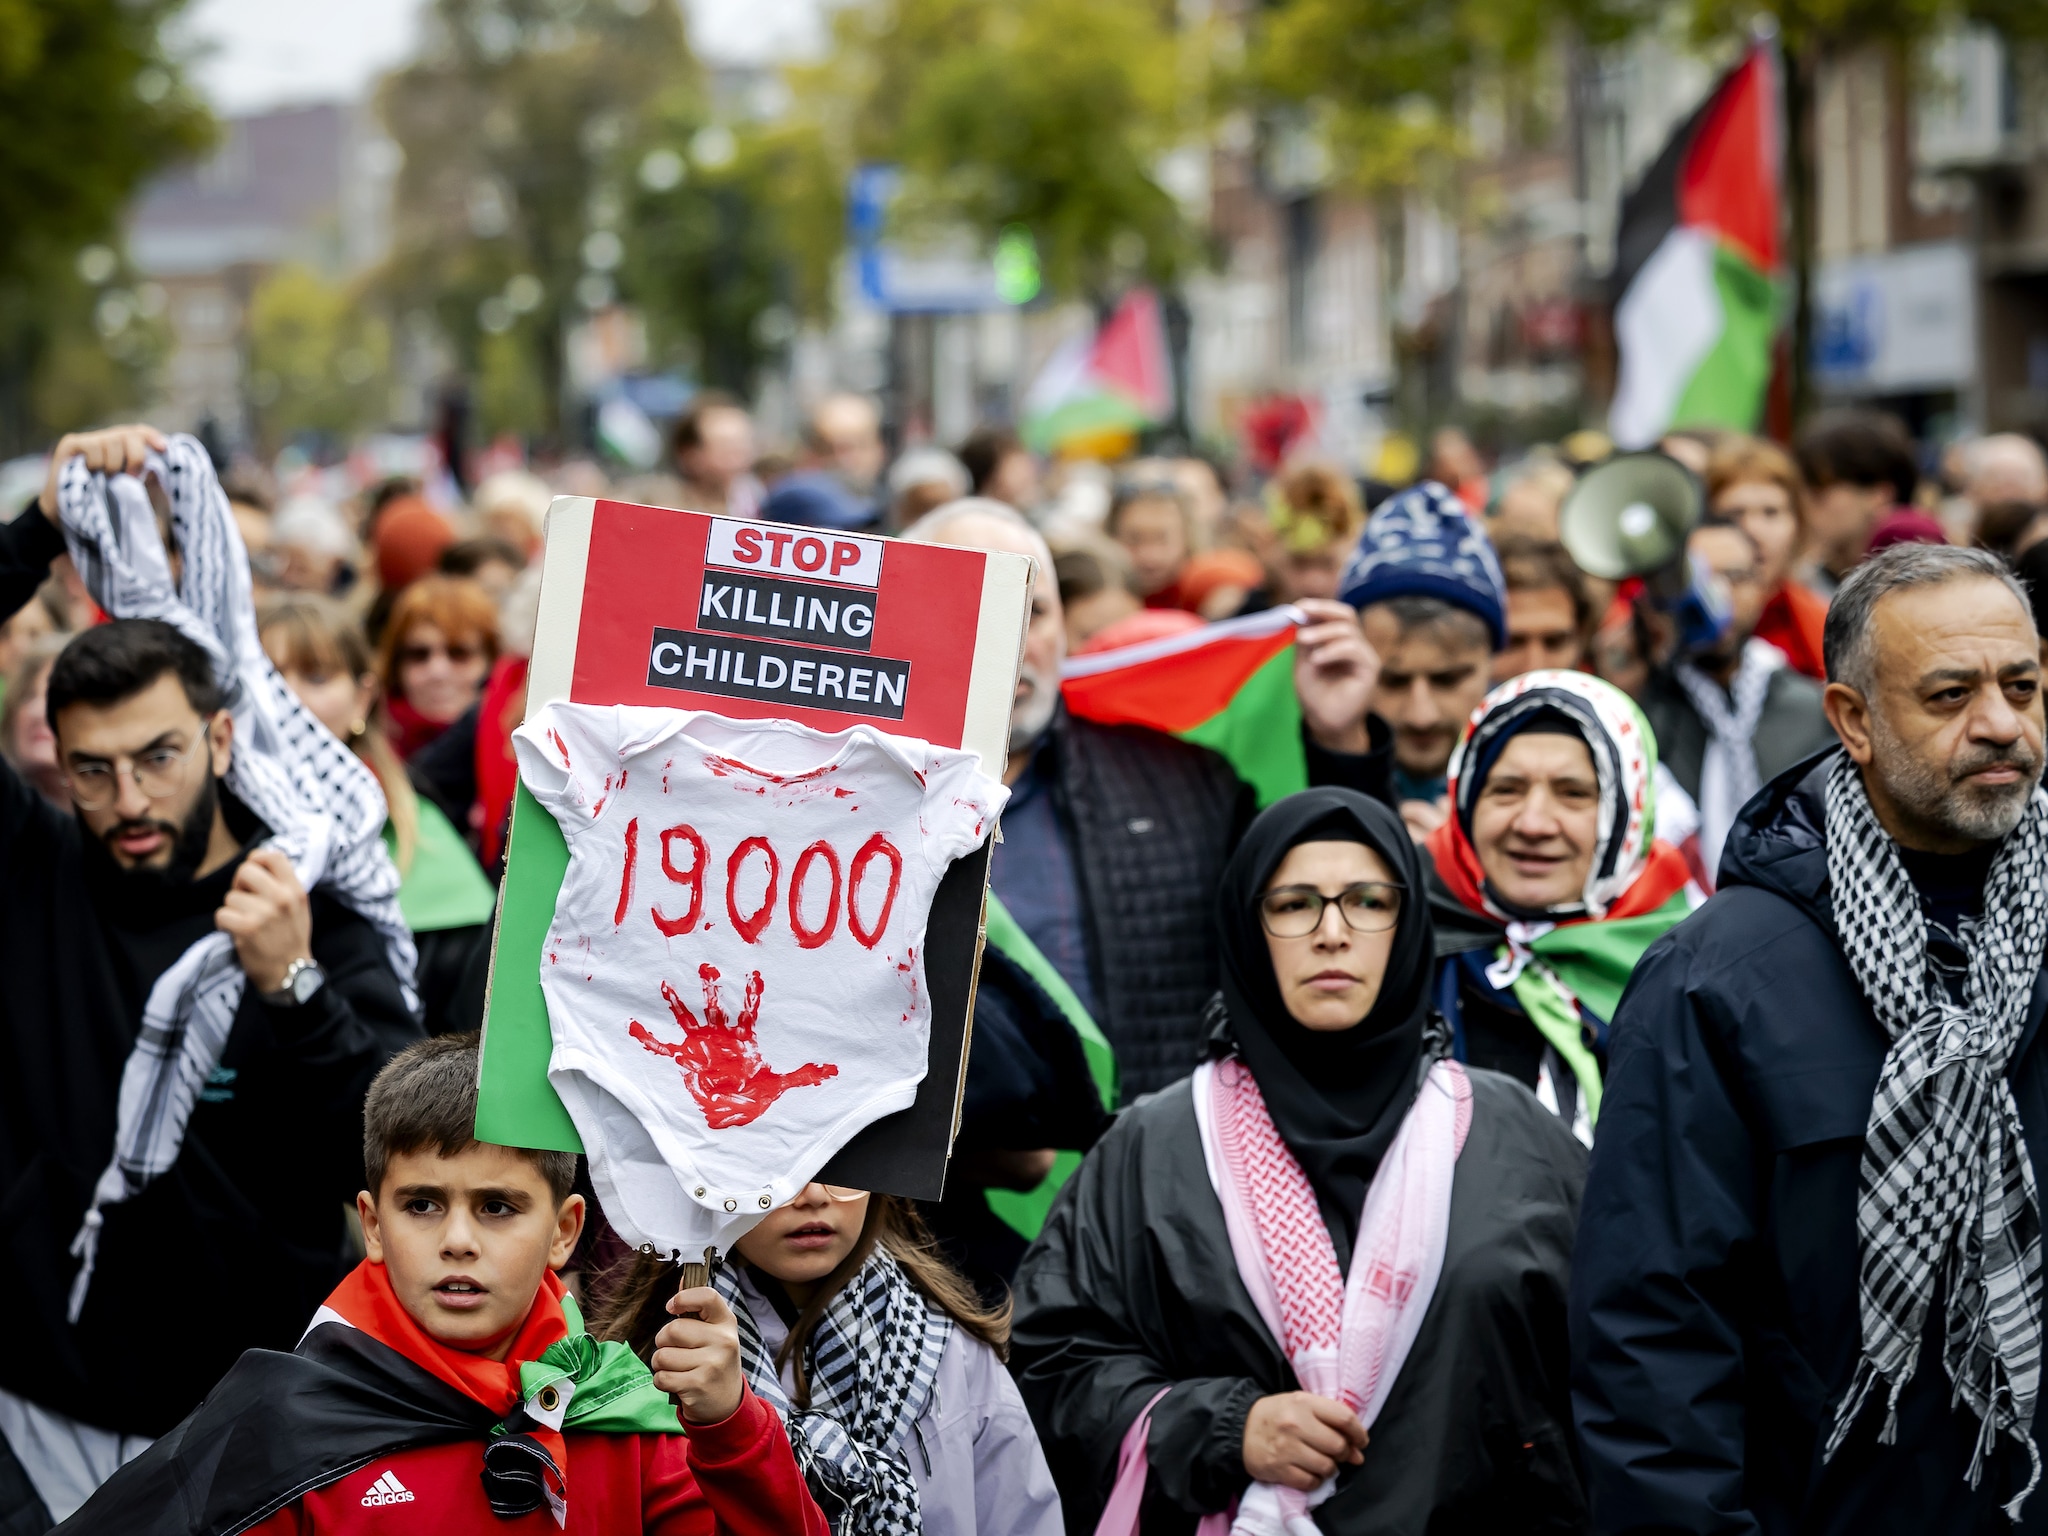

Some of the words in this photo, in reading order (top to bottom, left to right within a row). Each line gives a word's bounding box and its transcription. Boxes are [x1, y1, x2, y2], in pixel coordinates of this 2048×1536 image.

[733, 529, 861, 576] STOP
[702, 584, 873, 638] KILLING
[651, 641, 906, 706] CHILDEREN
[615, 817, 902, 949] 19.000
[361, 1491, 415, 1507] adidas
